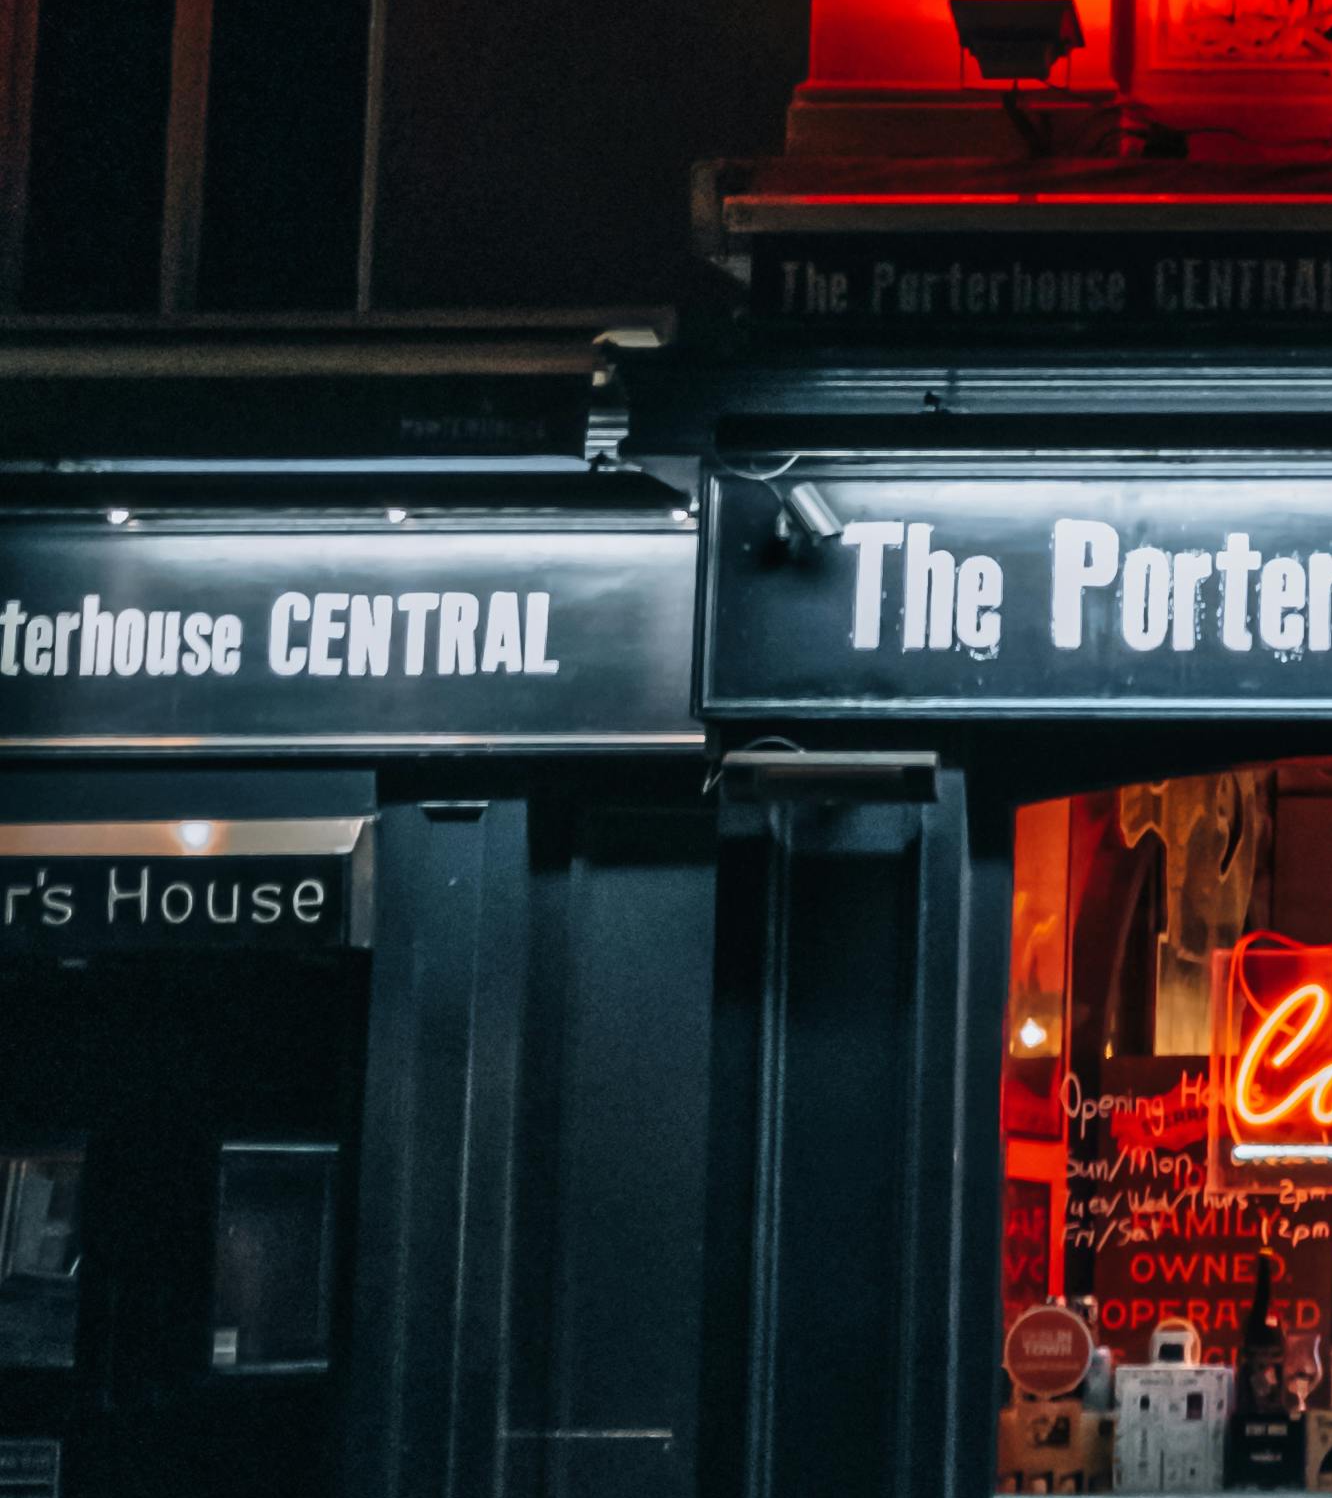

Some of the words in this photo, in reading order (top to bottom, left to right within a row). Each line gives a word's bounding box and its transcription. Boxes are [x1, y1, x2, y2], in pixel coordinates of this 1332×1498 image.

[779, 259, 849, 314] The
[868, 259, 1127, 314] Porterhouse
[840, 520, 1004, 656] The
[267, 591, 559, 676] CENTRAL
[107, 865, 326, 925] House
[1060, 1070, 1166, 1140] Opening
[1132, 1207, 1282, 1241] FAMILY
[1278, 1178, 1327, 1212] 2pm
